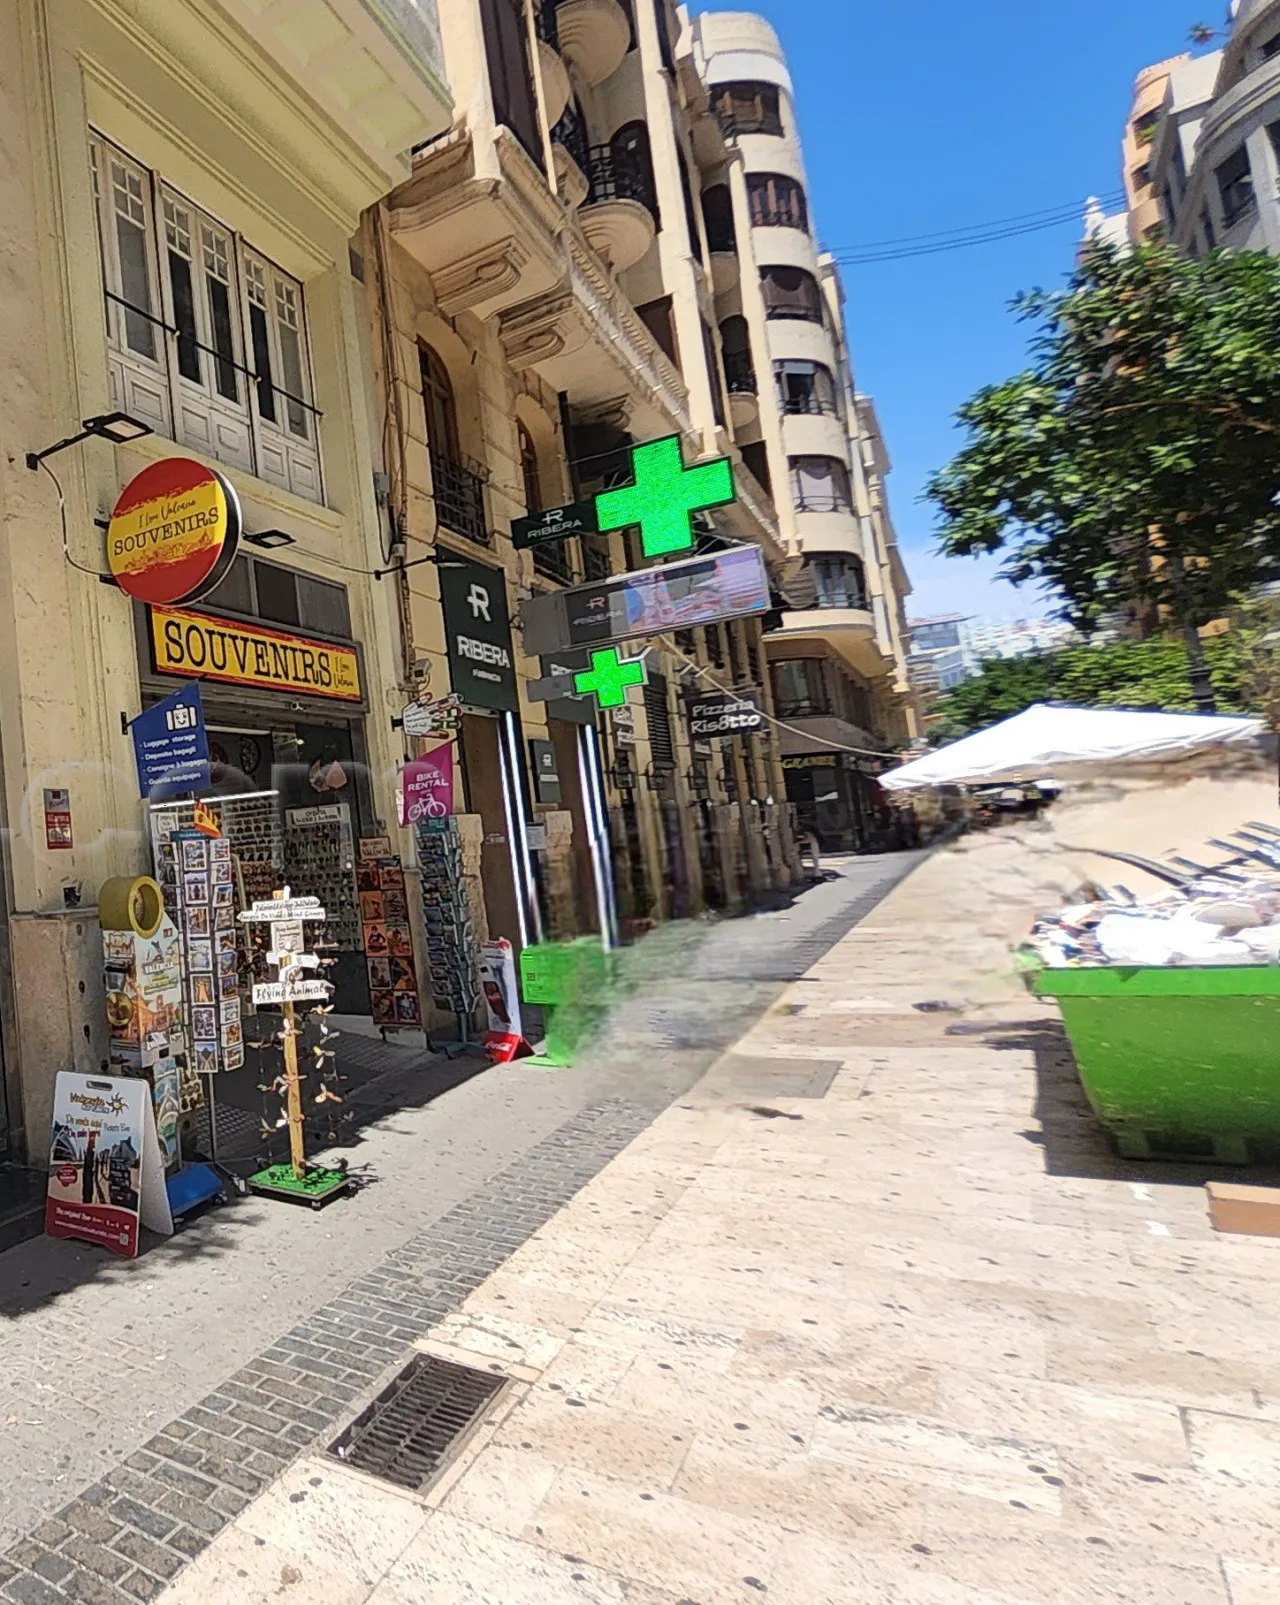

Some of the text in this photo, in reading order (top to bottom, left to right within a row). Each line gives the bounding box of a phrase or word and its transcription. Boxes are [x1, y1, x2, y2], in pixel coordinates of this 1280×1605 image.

[114, 507, 219, 555] SOUVENIRS
[528, 518, 582, 539] RIBERA
[165, 620, 332, 688] SOUVENIRS
[457, 635, 510, 668] RIBERA
[693, 700, 754, 717] Pizzeria
[143, 733, 196, 749] Luggage storage
[147, 762, 175, 774] Consigne
[149, 772, 201, 785] Guarda equipajes
[408, 778, 449, 791] RENTAL
[416, 771, 439, 782] BIKE
[256, 984, 286, 1000] Flying
